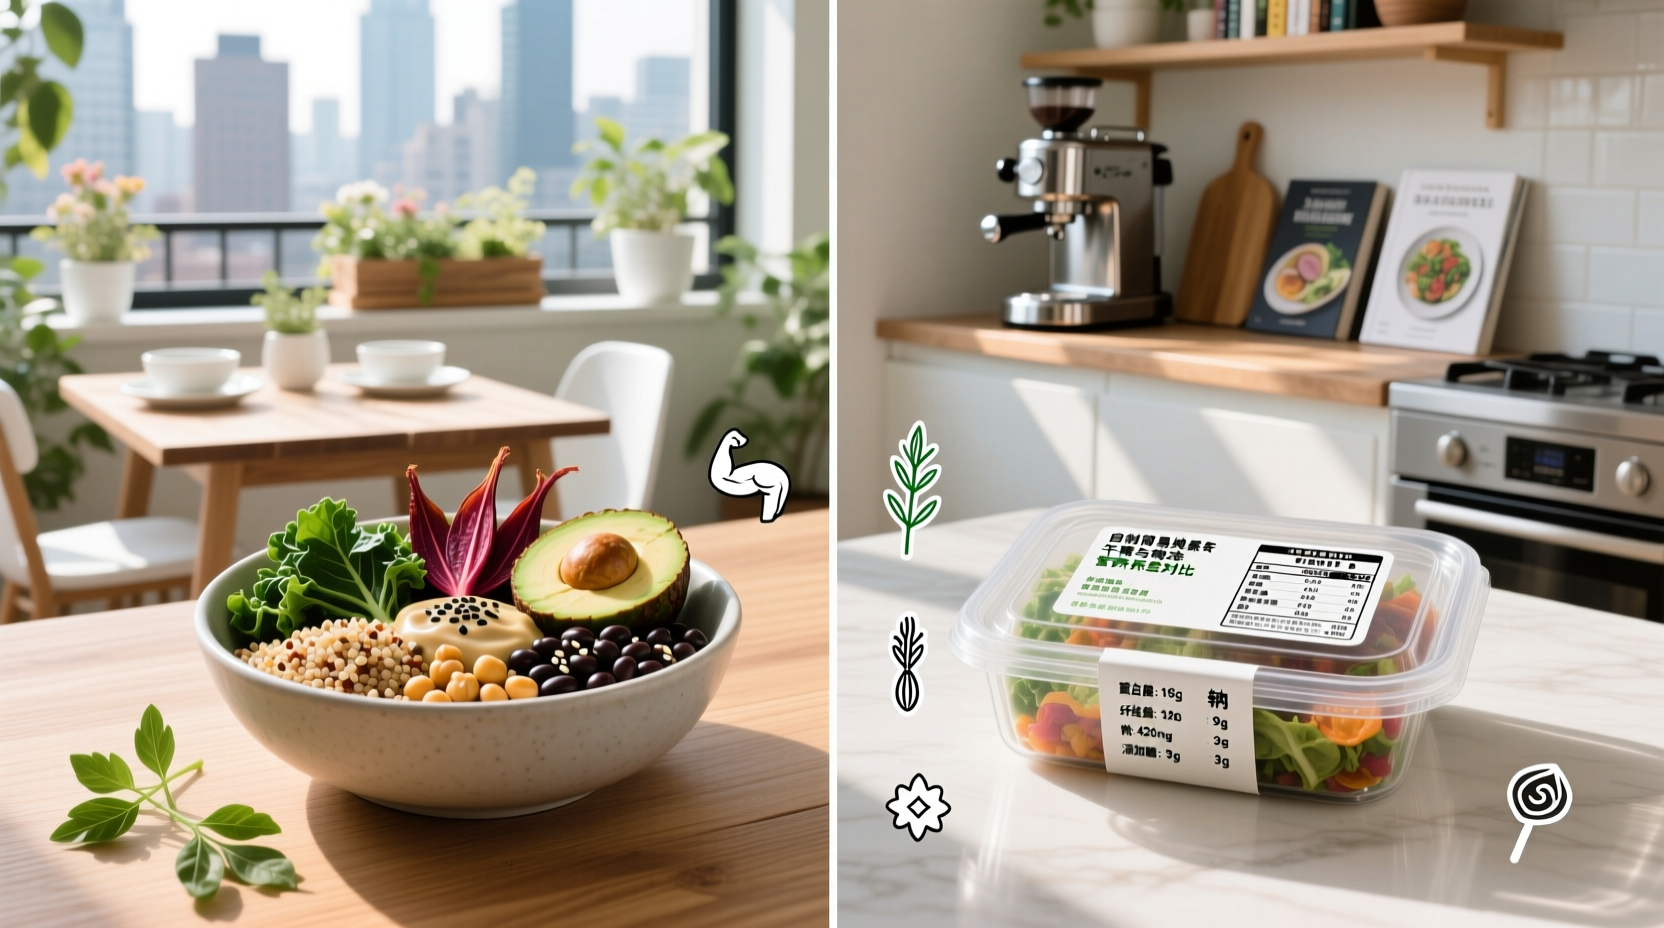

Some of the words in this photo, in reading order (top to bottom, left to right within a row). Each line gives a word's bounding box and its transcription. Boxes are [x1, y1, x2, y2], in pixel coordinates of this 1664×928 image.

[1212, 716, 1228, 731] 9g
[1213, 736, 1229, 749] 3g
[1214, 754, 1230, 769] 3g
